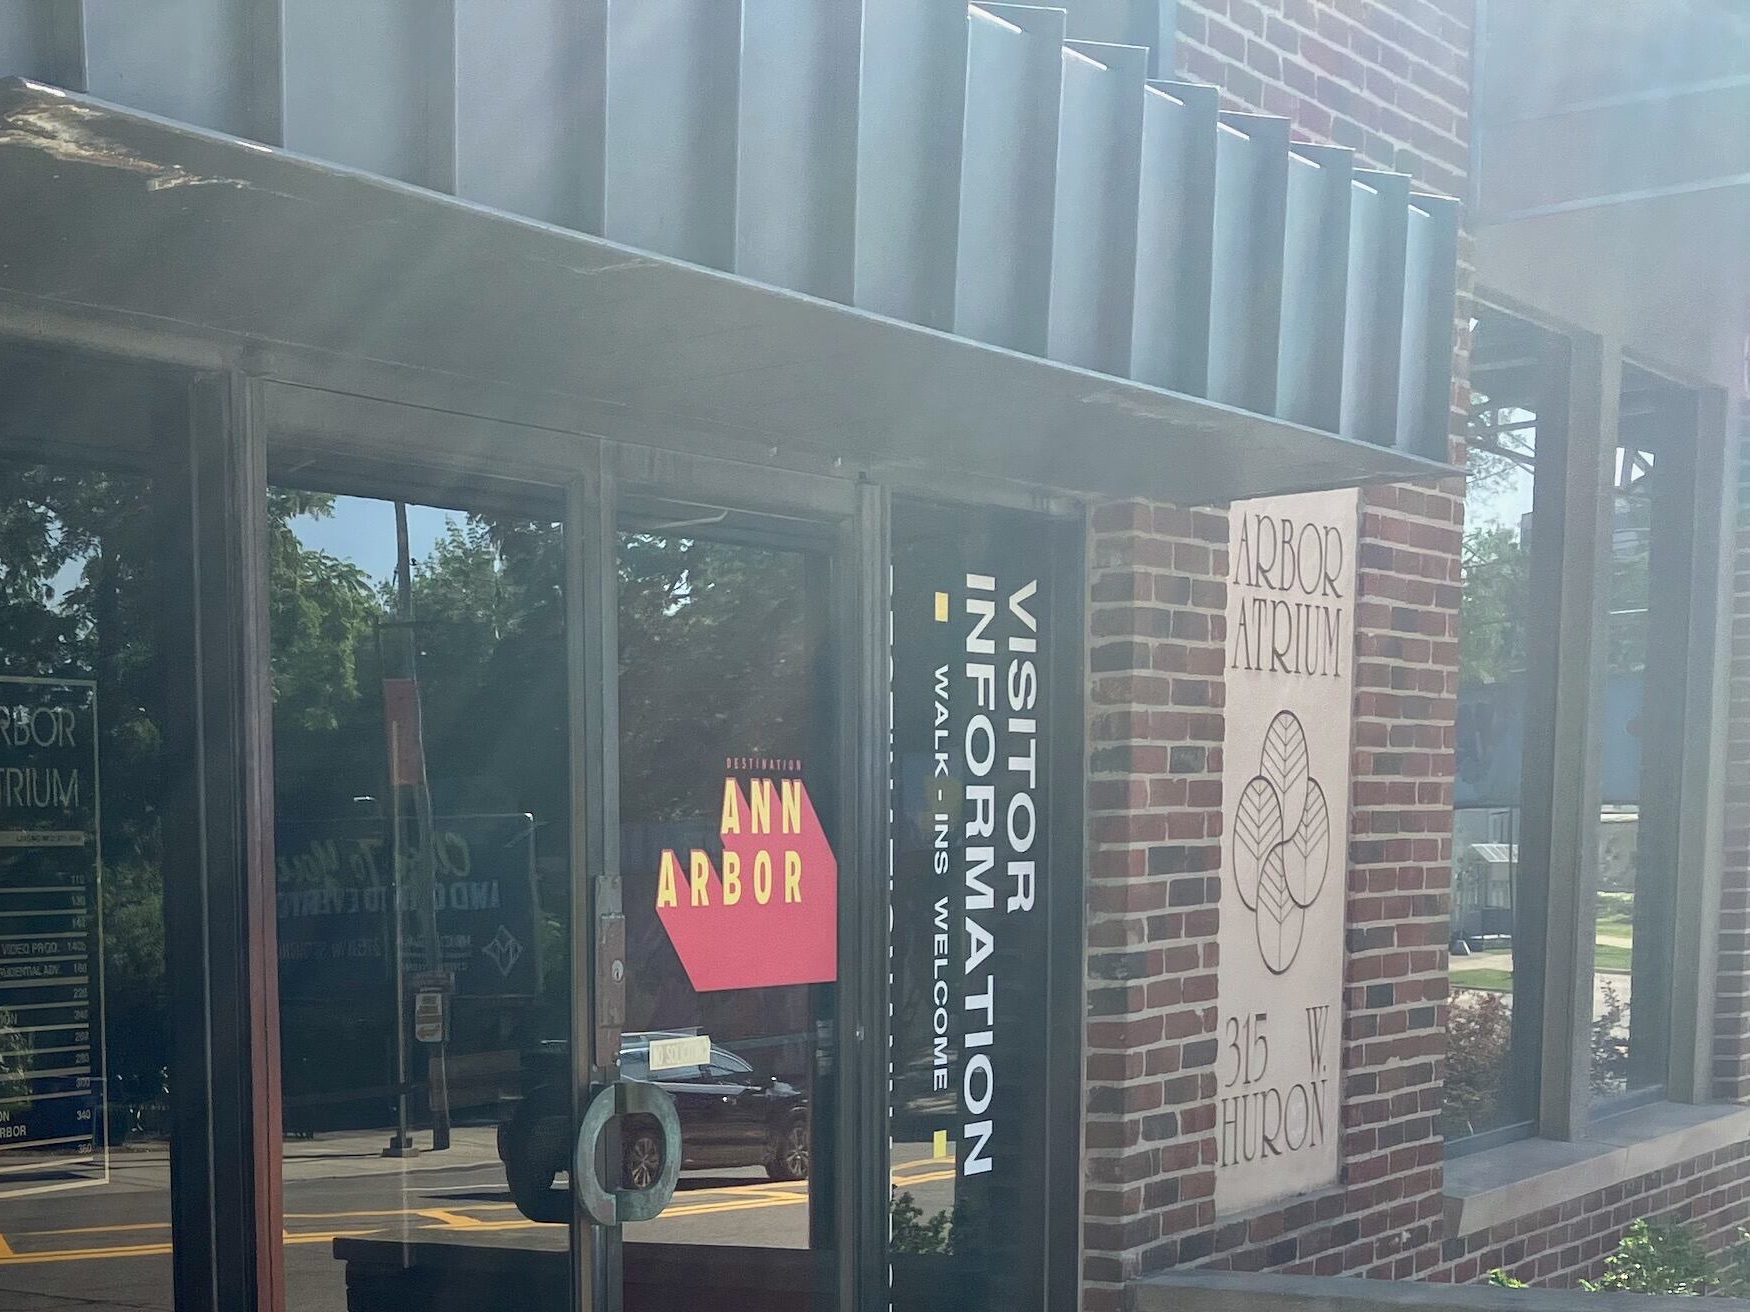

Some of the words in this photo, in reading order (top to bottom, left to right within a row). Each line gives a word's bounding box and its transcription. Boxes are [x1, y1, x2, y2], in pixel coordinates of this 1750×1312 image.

[1233, 510, 1343, 599] ARBOR
[1231, 595, 1343, 678] ATRIUM
[726, 757, 803, 771] DESTINATION
[1007, 579, 1038, 914] VISITOR
[720, 777, 802, 835] ANN
[656, 848, 803, 908] ARBOR
[963, 573, 996, 1176] INFORMATION
[2, 943, 29, 955] VIDEO
[933, 896, 949, 1091] WELCOME
[1225, 1012, 1268, 1088] 315
[1305, 1004, 1330, 1073] W.
[1220, 1079, 1328, 1168] HURON
